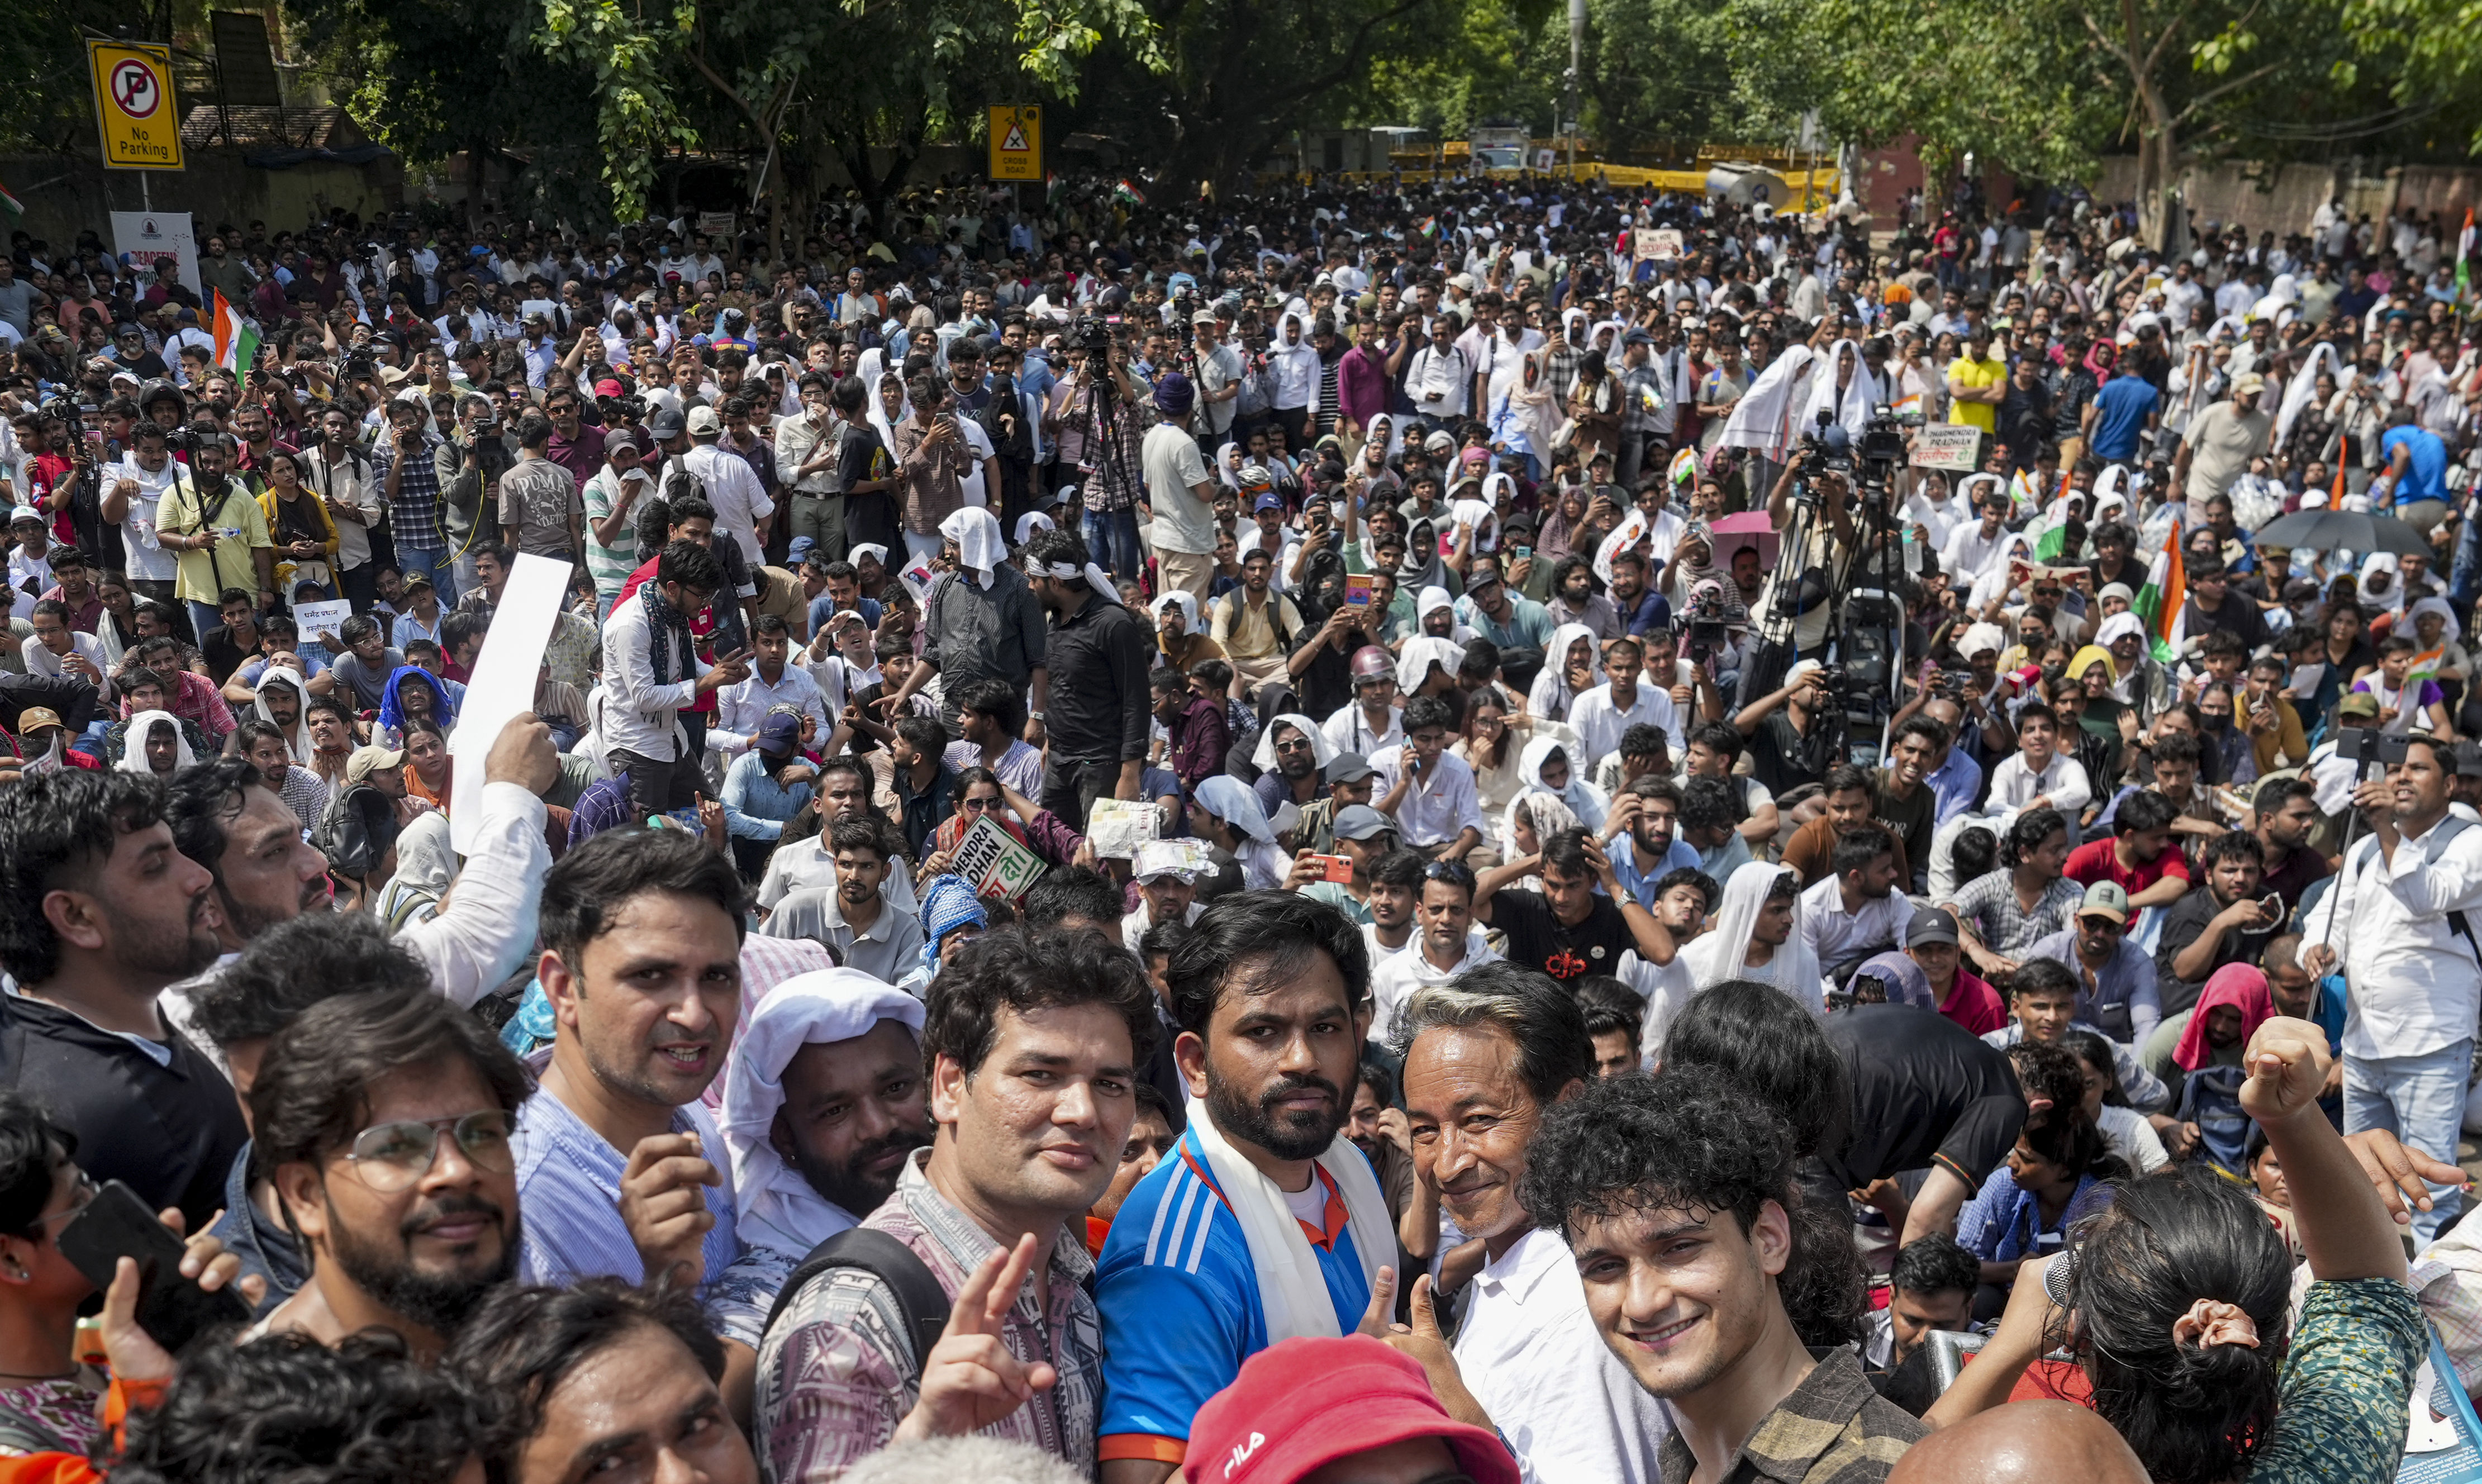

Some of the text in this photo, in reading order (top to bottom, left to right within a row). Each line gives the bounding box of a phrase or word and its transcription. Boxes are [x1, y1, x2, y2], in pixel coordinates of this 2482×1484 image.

[131, 127, 149, 140] No
[120, 141, 168, 159] Parking
[1931, 437, 1971, 446] PRADHAN
[516, 473, 567, 503] PUMA
[306, 624, 329, 633] इस्तीफा
[952, 824, 991, 877] MENDRA
[1224, 1431, 1266, 1478] FILA
